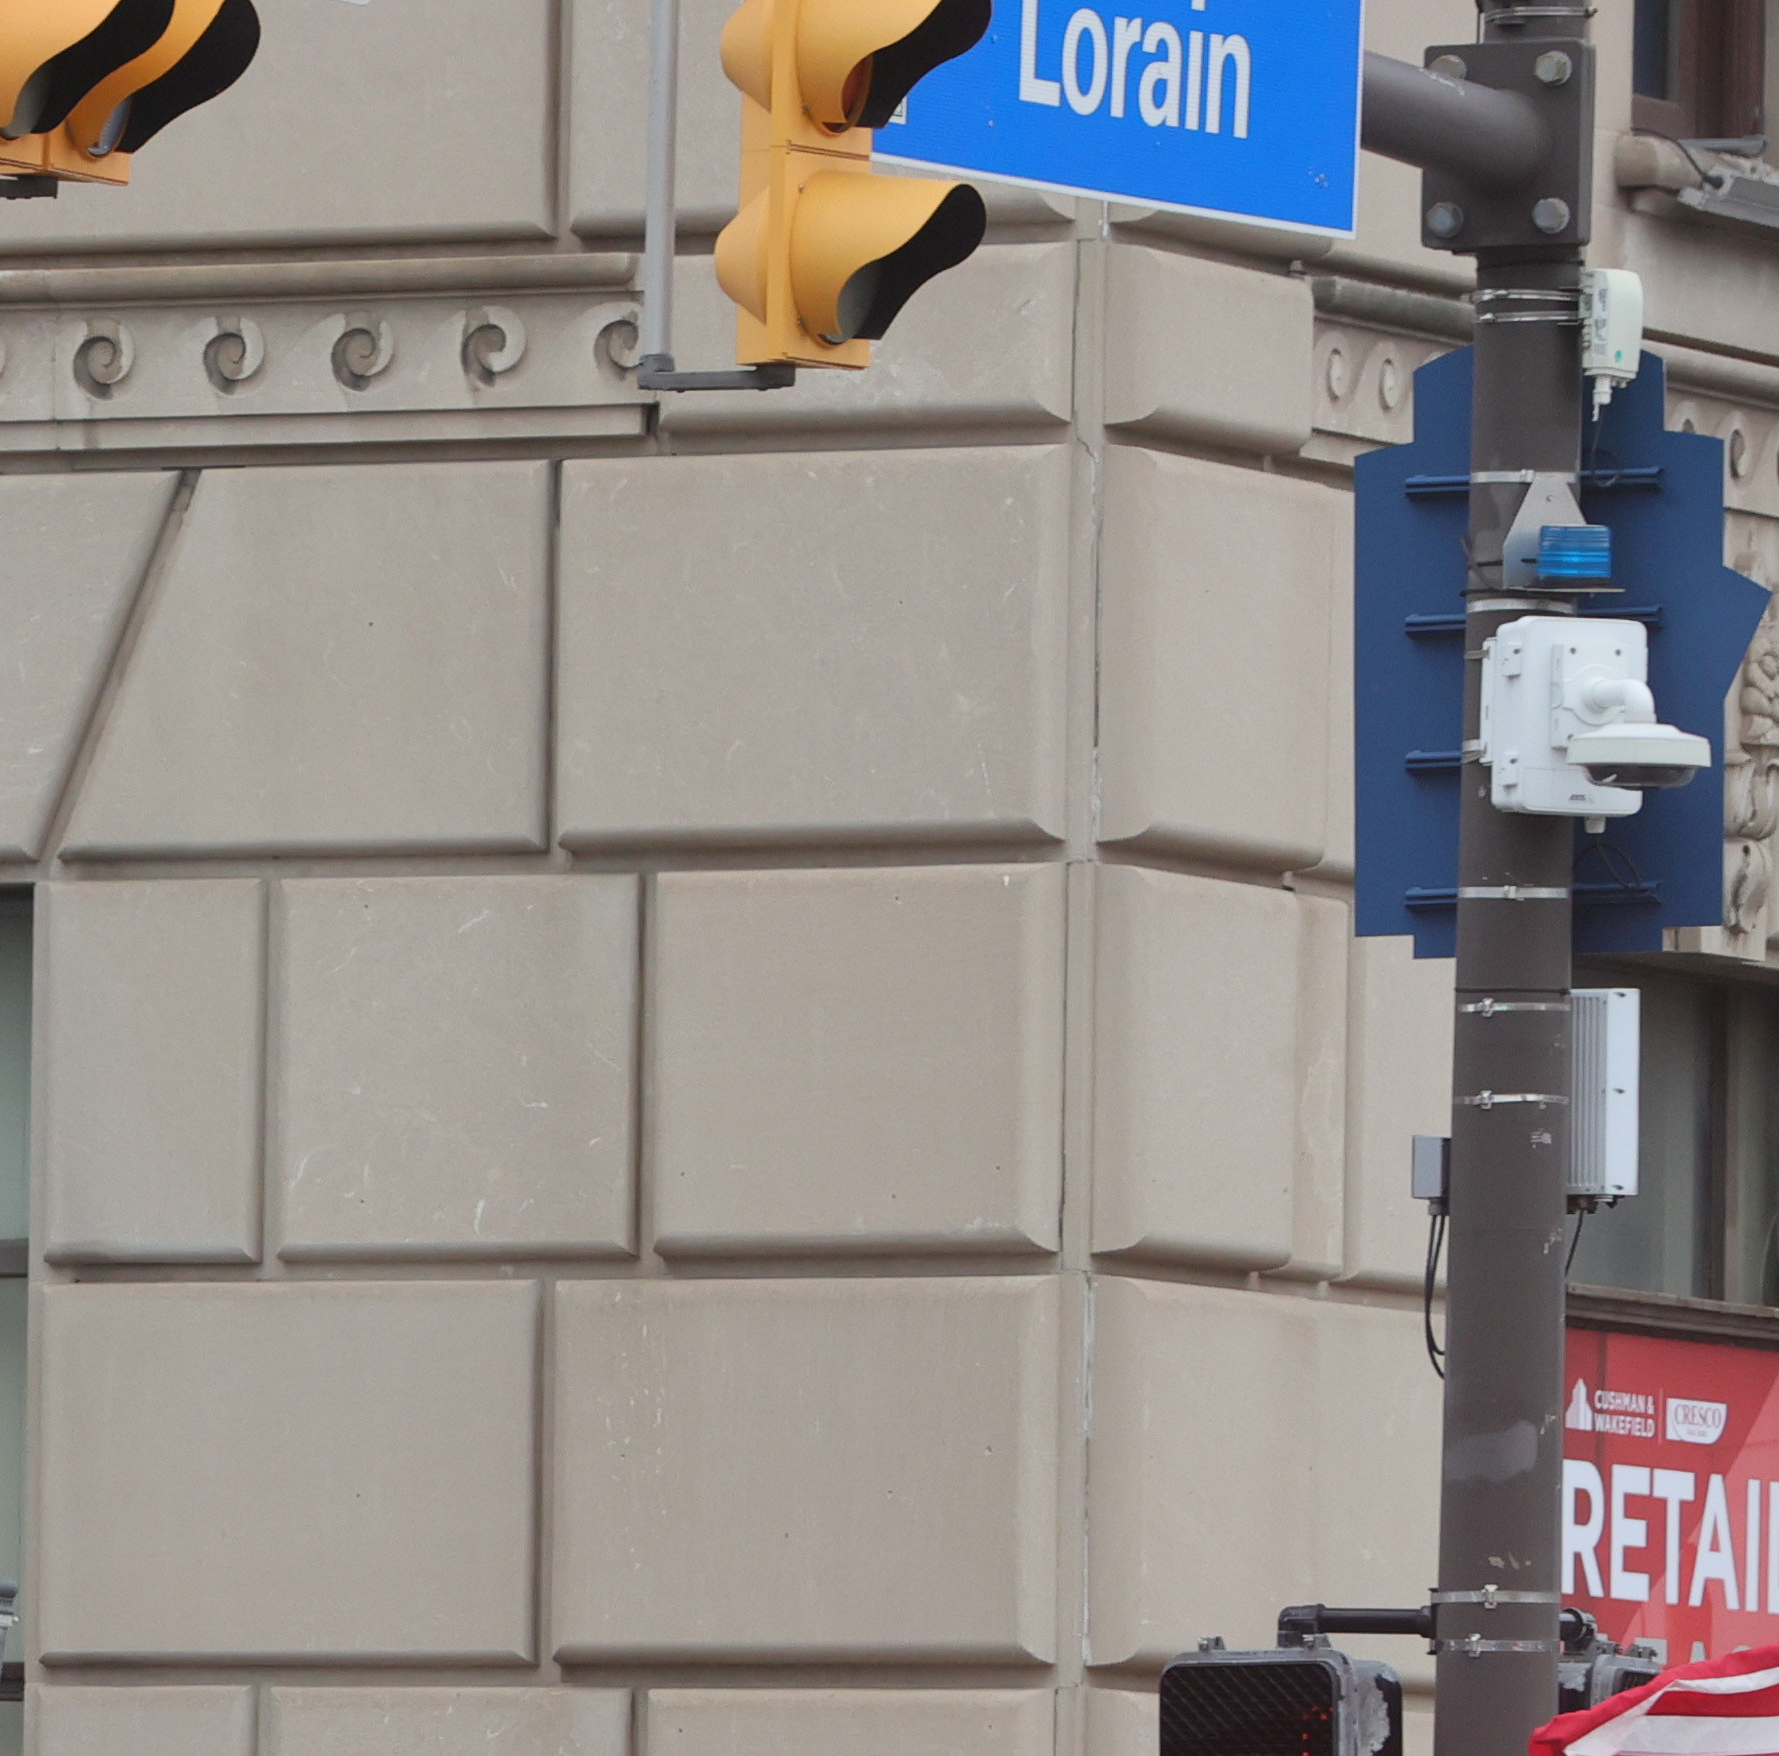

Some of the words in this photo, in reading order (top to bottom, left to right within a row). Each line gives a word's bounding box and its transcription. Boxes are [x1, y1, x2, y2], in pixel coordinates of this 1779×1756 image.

[1019, 0, 1251, 139] Lorain
[1594, 1412, 1655, 1438] WAKEFIELD
[1674, 1403, 1722, 1429] CRESCO
